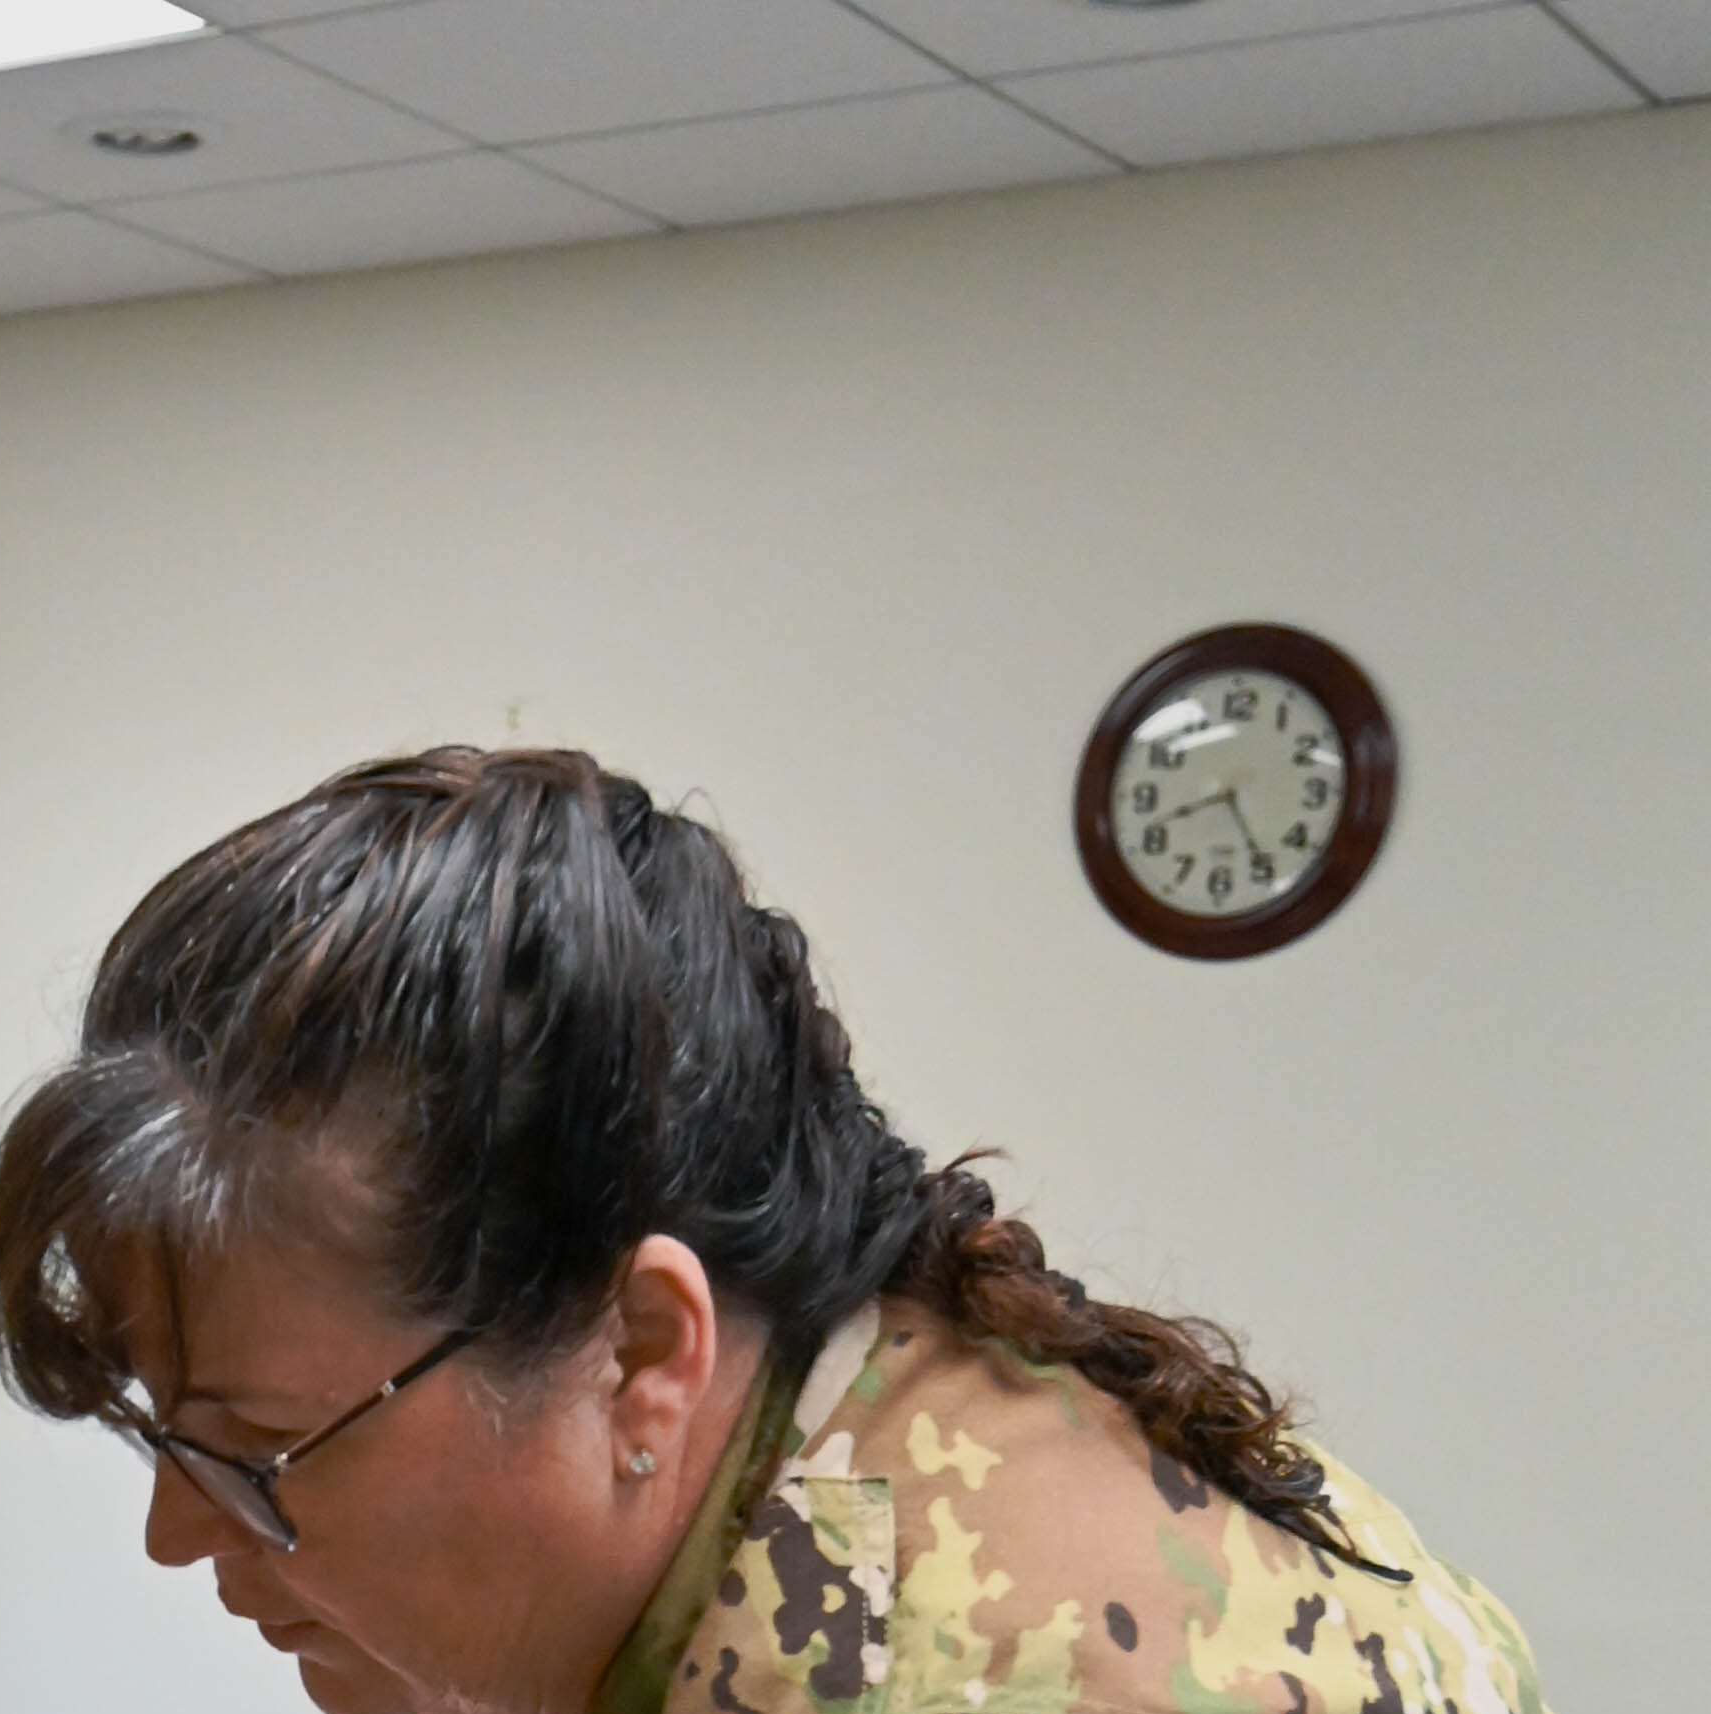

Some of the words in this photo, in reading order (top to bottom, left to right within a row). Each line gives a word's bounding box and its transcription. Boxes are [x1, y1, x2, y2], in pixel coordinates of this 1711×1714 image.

[1223, 688, 1258, 721] 12
[1275, 700, 1288, 731] 1
[1292, 733, 1319, 767] 2
[1132, 782, 1158, 815] 9
[1303, 777, 1328, 811] 3
[1142, 823, 1168, 855] 8
[1281, 822, 1308, 850] 4
[1174, 853, 1195, 885] 7
[1207, 866, 1233, 897] 6
[1250, 852, 1274, 884] 5
